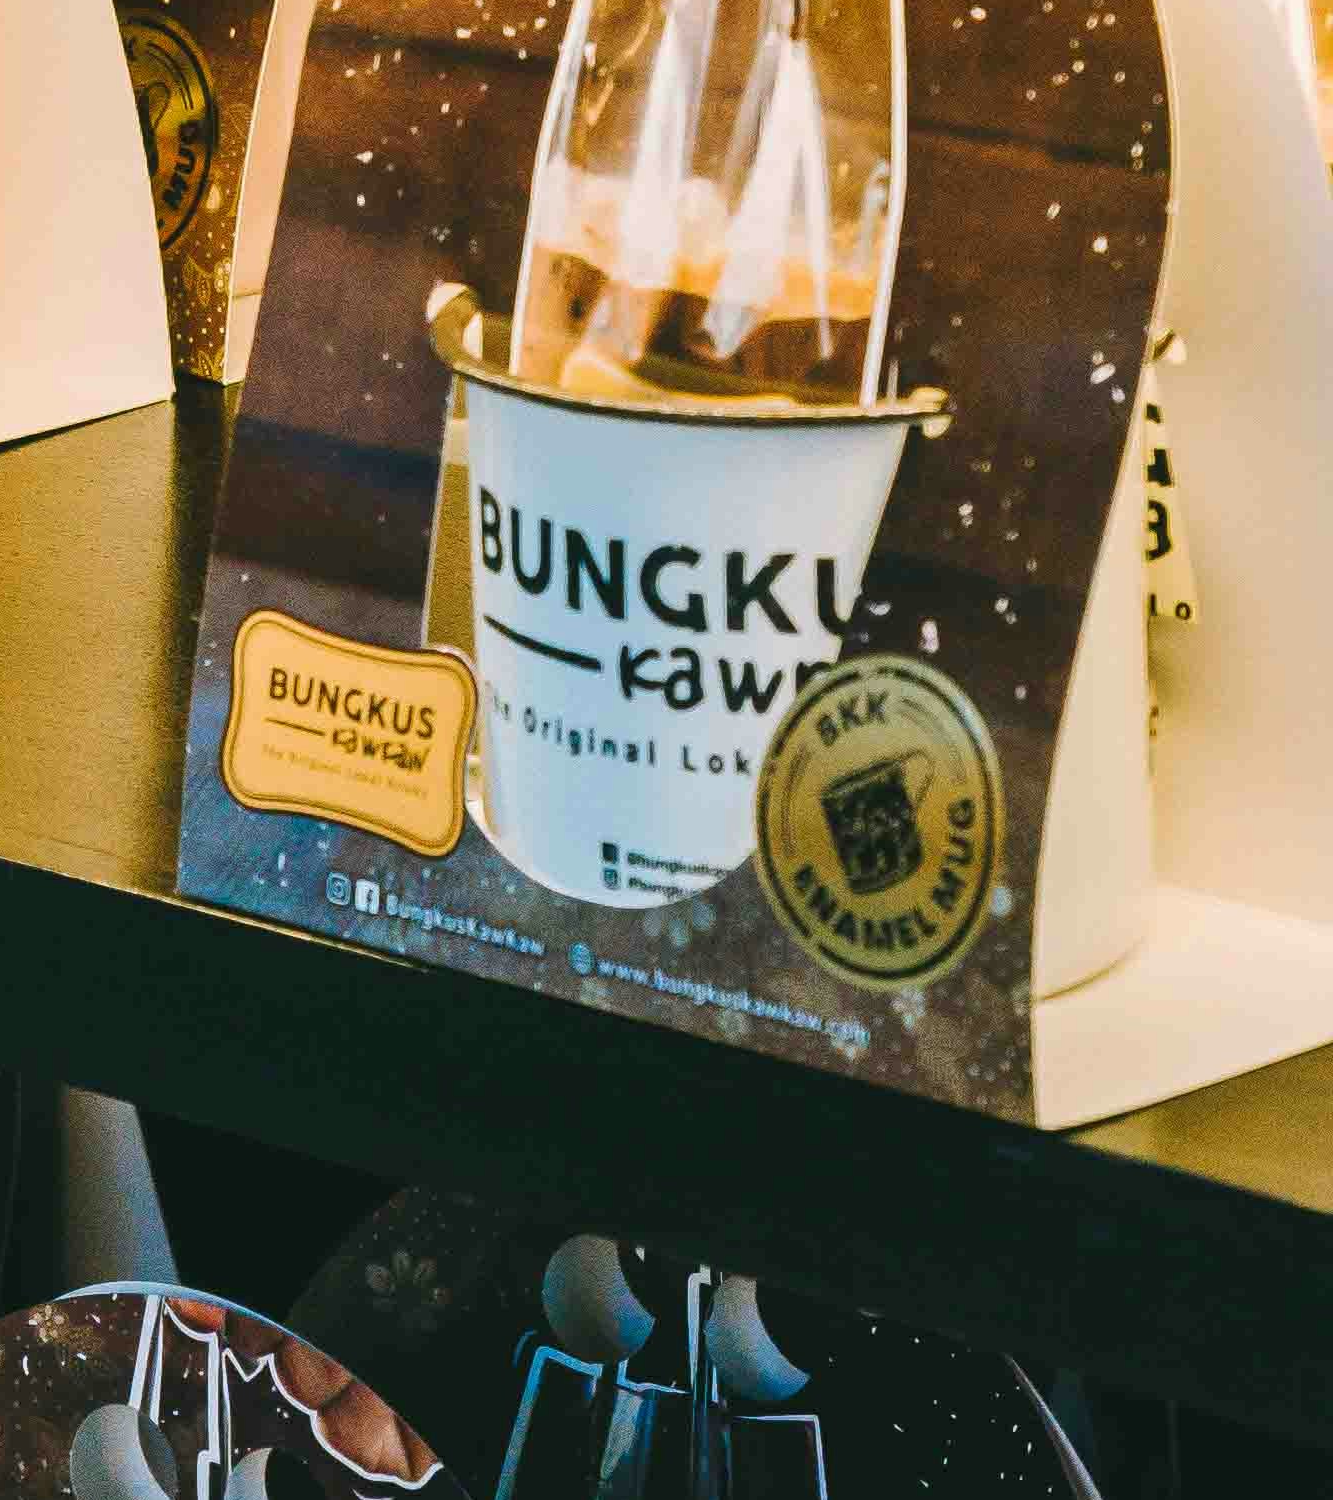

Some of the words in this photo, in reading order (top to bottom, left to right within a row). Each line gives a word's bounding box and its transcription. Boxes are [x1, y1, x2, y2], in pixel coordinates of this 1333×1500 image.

[269, 666, 435, 740] BUNGKUS
[523, 705, 656, 768] Original
[816, 692, 889, 746] BKK
[794, 862, 937, 950] ENAMEL
[929, 798, 975, 912] MUG
